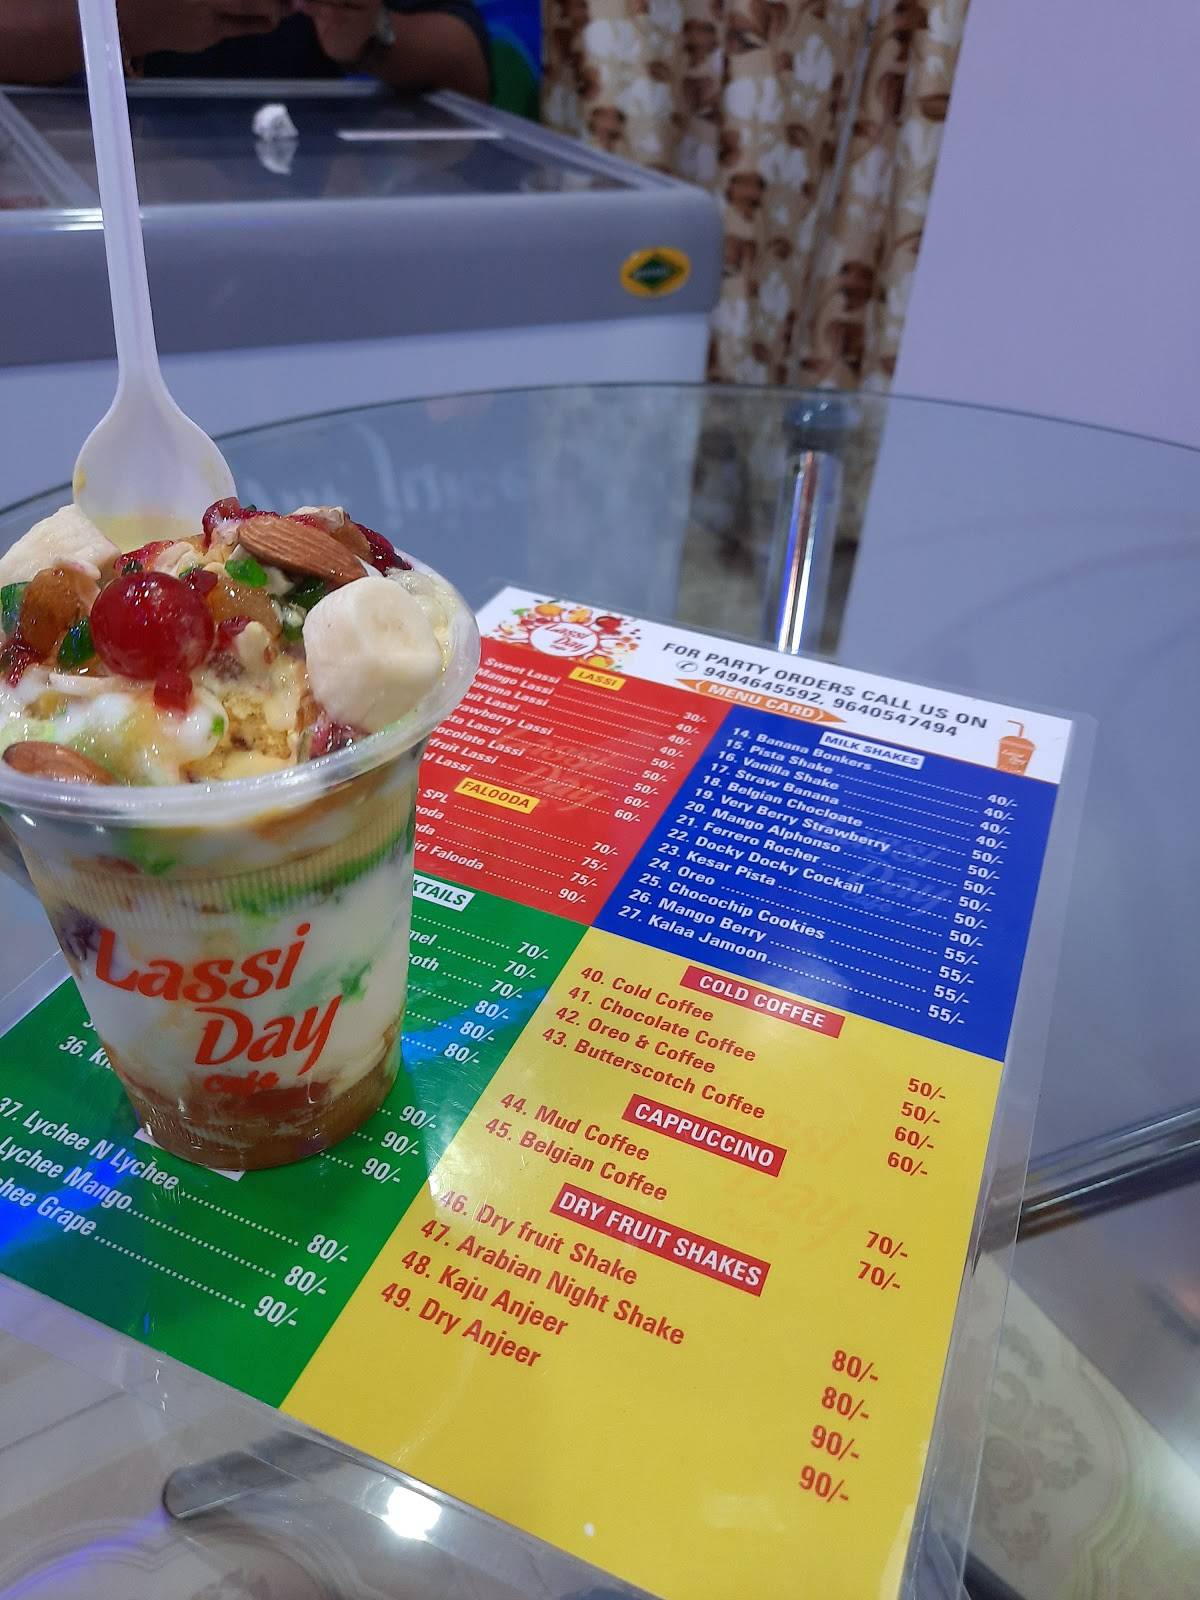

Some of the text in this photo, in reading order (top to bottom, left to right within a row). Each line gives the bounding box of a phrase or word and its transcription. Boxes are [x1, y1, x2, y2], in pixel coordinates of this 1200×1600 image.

[472, 681, 550, 707] anana Lassi
[477, 668, 701, 735] Mango Lassi 40/-
[484, 658, 708, 723] Sweet Lassi 30/-
[577, 671, 617, 687] LASSI
[662, 642, 988, 729] FOR PARTY ORDERS CALL US ON
[708, 684, 814, 718] MENU CARD
[434, 727, 486, 746] ocolate
[488, 740, 526, 757] Lassi
[456, 704, 515, 726] rawberry
[517, 720, 552, 736] Lassi
[651, 758, 677, 770] 50/-
[466, 719, 503, 736] Lassi
[833, 698, 958, 737] 9640547494
[725, 739, 833, 775] 15. Pista Shake
[733, 727, 1018, 807] 14. Banana Bonkers 40/-
[824, 735, 920, 767] MILK SHAKES
[462, 781, 530, 808] FALOODA
[623, 796, 650, 809] 60/-
[710, 763, 840, 805] 17. Straw Banana
[718, 751, 1012, 835] 16. Vanilla Shake 40/-
[422, 788, 619, 856] SPL 70/-
[675, 814, 698, 829] 21.
[702, 822, 760, 847] Ferrero
[763, 839, 821, 864] Rocher
[684, 801, 707, 816] 20.
[711, 808, 765, 832] Mango
[767, 824, 842, 853] Alphonso
[695, 788, 892, 852] 19. Very Berry Strawberry
[702, 775, 1005, 865] 18. Belgian Chocloate 50/-
[413, 880, 467, 906] KTAILS
[430, 845, 484, 870] Falooda
[558, 888, 587, 904] 90/-
[580, 856, 609, 871] 75/-
[657, 842, 777, 887] 23. Kesar Pista
[667, 828, 988, 929] 22. Docky Docky Cockail 50/-
[638, 873, 826, 940] 25. Chocochip Cookies
[648, 857, 980, 965] 24. Oreo 55/-
[95, 922, 311, 1003] Lassi
[516, 941, 549, 961] 70/-
[618, 905, 643, 922] 27.
[648, 914, 696, 940] Kalaa
[927, 1004, 965, 1025] 55/-
[628, 888, 970, 1004] 26. Mango Berry 55/-
[474, 1000, 510, 1020] 80/-
[489, 979, 523, 1000] 70/-
[699, 975, 827, 1029] COLD COFFEE
[59, 1035, 88, 1058] 36.
[194, 994, 343, 1077] Day
[443, 1042, 480, 1065] 80/-
[567, 986, 757, 1063] 41. Chocolate Coffee
[580, 966, 947, 1101] 40. Cold Coffee 50/-
[542, 1027, 766, 1120] 43. Butterscotch Coffee
[555, 1006, 935, 1150] 42. Oreo & Coffee 60/-
[399, 1105, 437, 1130] 90/-
[634, 1102, 775, 1168] CAPPUCCINO
[0, 1136, 64, 1178] Lychee
[0, 1097, 349, 1263] 37. Lychee N Lychee 80/-
[361, 1157, 401, 1184] 90/-
[500, 1093, 908, 1259] 44. Mud Coffee 70/-
[485, 1118, 901, 1290] 45. Belgian Coffee 70/-
[37, 1196, 298, 1327] Grape 90/-
[558, 1191, 605, 1222] DRY
[606, 1211, 672, 1248] FRUIT
[672, 1236, 763, 1287] SHAKES
[420, 1219, 686, 1346] 47. Arabian Night Shake
[439, 1189, 879, 1383] 46. Dry fruit Shake 80/-
[401, 1250, 860, 1461] 48. Kaju Anjeer 90/-
[381, 1282, 849, 1503] 49. Dry Anjeer 90/-
